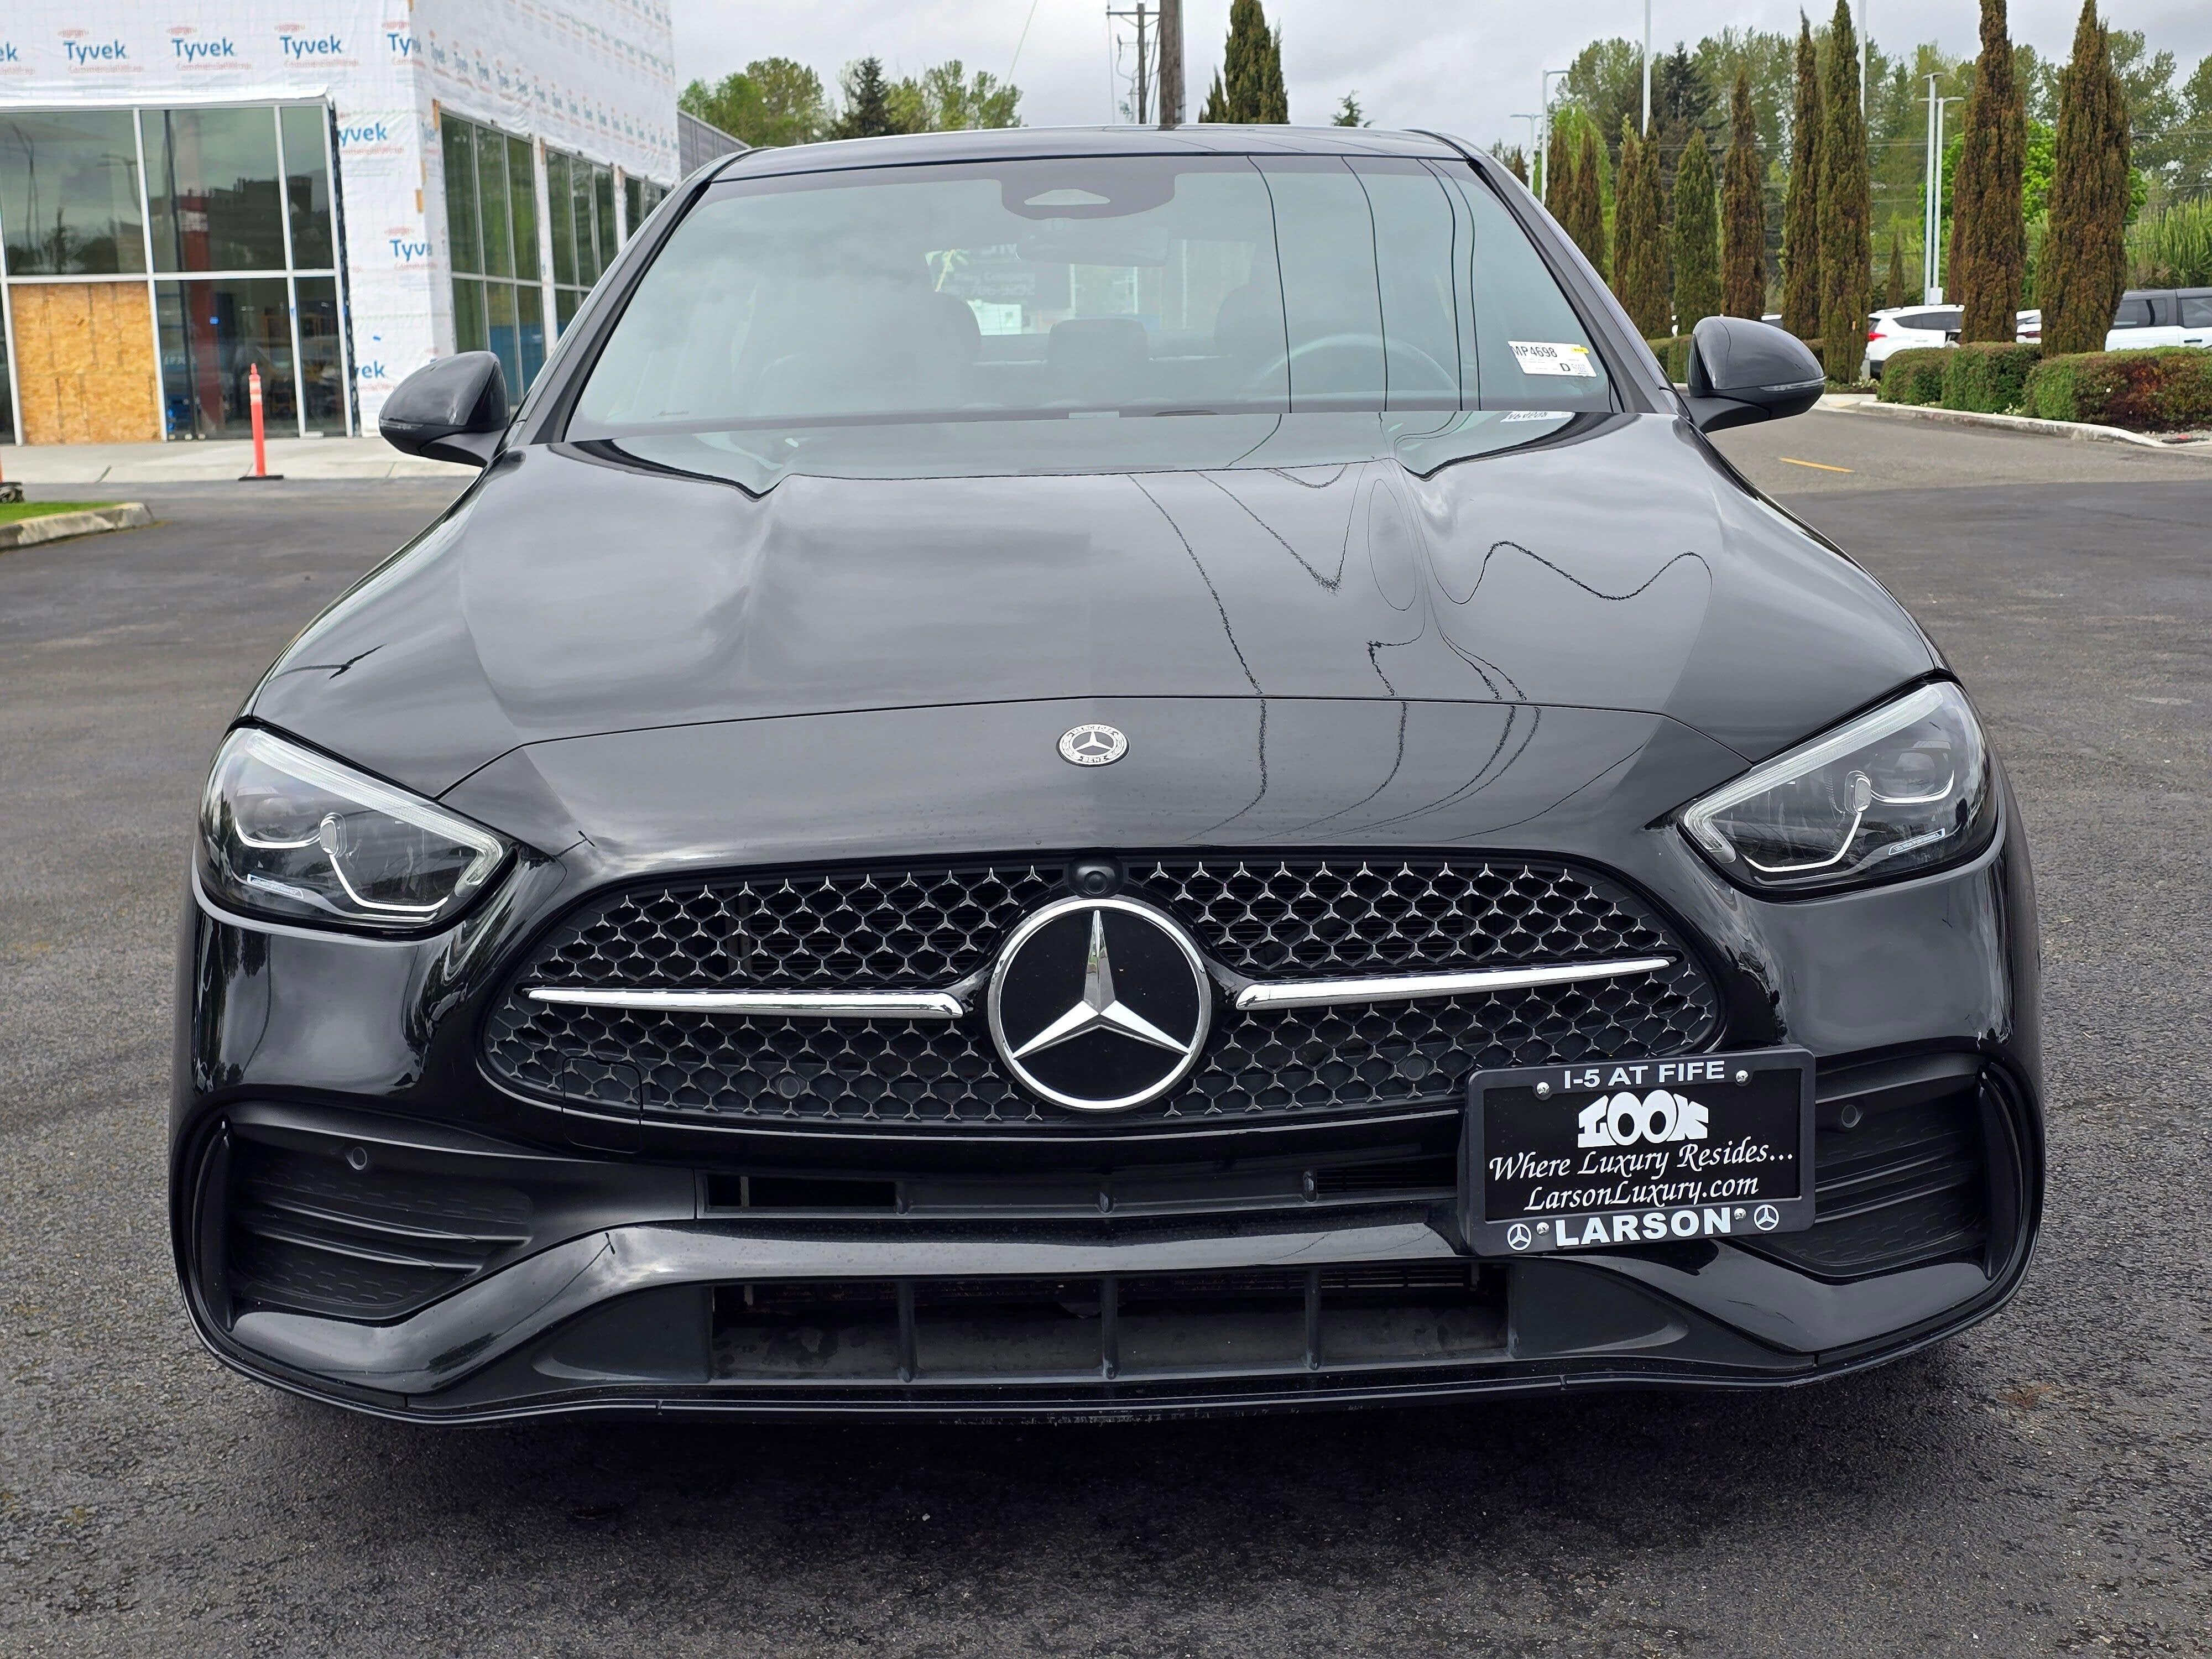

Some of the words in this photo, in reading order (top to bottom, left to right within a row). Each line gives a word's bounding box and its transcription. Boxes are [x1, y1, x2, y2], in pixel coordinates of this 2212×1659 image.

[63, 39, 126, 65] Tyvek
[172, 36, 234, 62] Tyvek
[280, 34, 342, 60] Tyvek
[1559, 363, 1571, 372] D
[1564, 1069, 1600, 1088] I-5
[1608, 1066, 1648, 1086] AT
[1659, 1061, 1725, 1083] FIFE
[1489, 1151, 1571, 1181] Where
[1577, 1151, 1670, 1180] Luxury
[1677, 1136, 1793, 1172] Resides...
[1524, 1177, 1759, 1211] LarsonLuxury.com
[1556, 1207, 1731, 1246] LARSON
